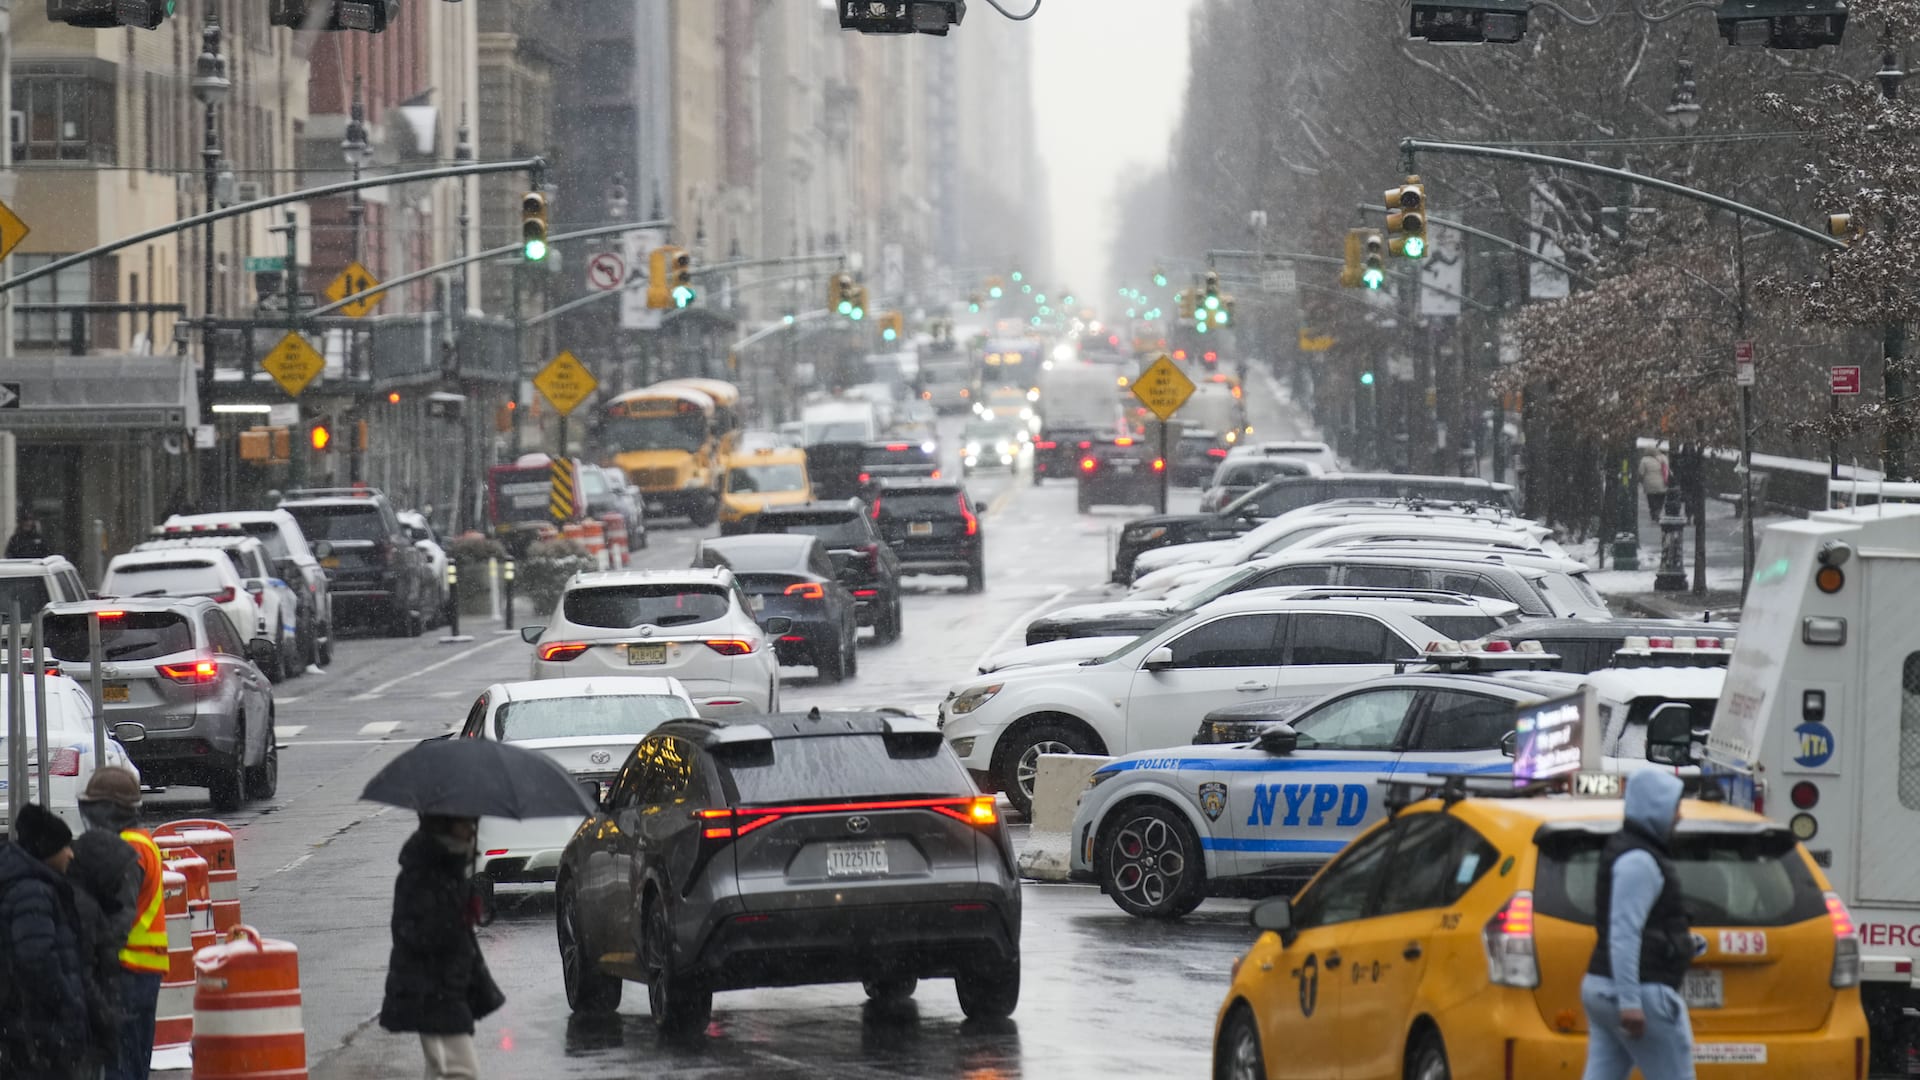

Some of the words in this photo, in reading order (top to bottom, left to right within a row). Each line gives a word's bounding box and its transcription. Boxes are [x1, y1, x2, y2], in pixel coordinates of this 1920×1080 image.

[1135, 758, 1179, 770] POLICE
[1578, 774, 1619, 796] 7V25
[1247, 784, 1368, 826] NYPD
[832, 850, 882, 867] T122517C
[1723, 931, 1765, 953] 139
